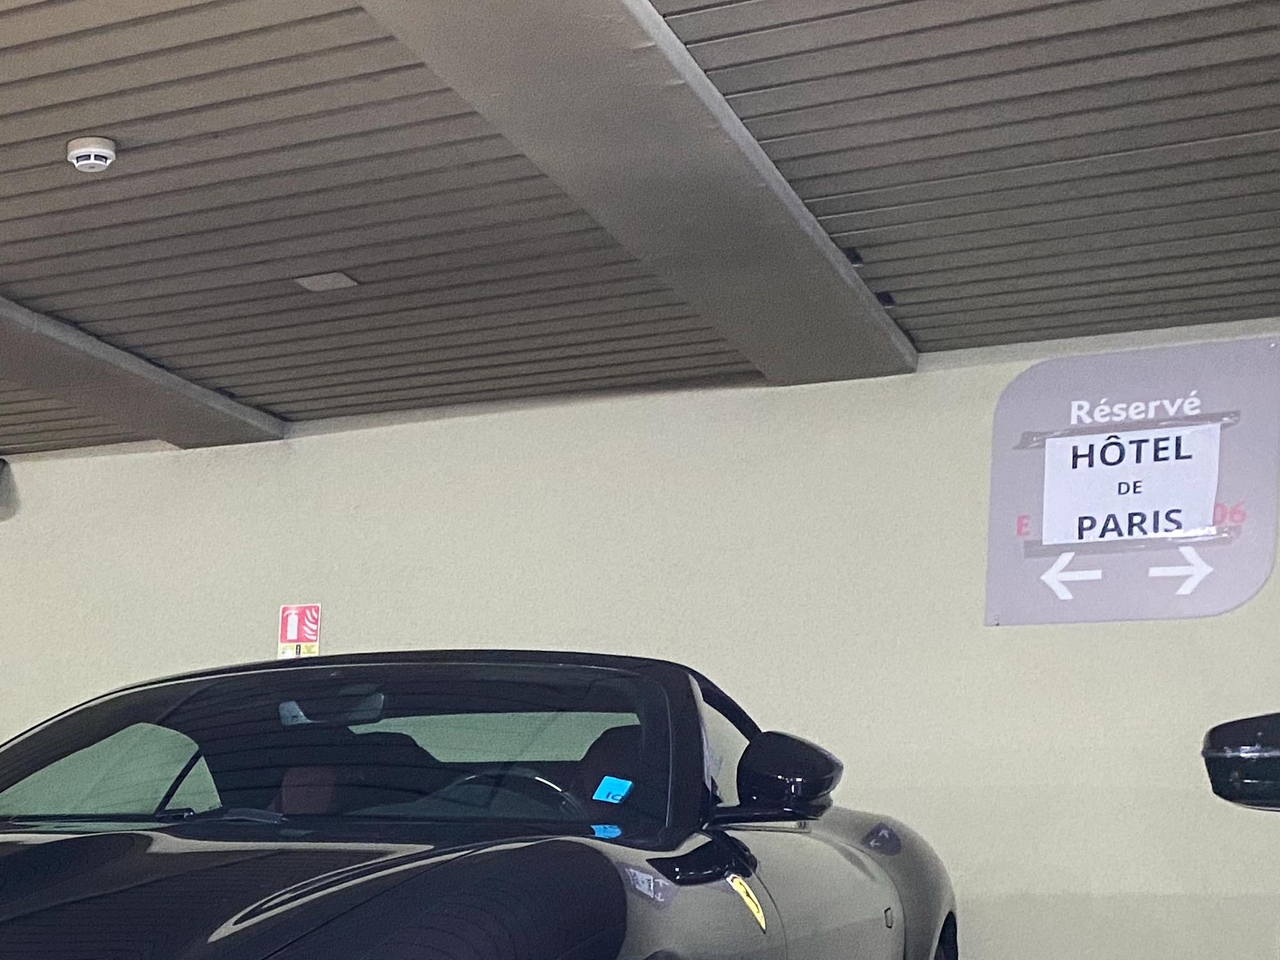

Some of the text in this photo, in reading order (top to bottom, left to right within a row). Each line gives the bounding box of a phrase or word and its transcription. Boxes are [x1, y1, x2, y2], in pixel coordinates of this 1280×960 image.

[1070, 390, 1202, 425] Réservé
[1071, 435, 1193, 470] HÔTEL
[1117, 480, 1143, 496] DE
[1077, 508, 1183, 540] PARIS
